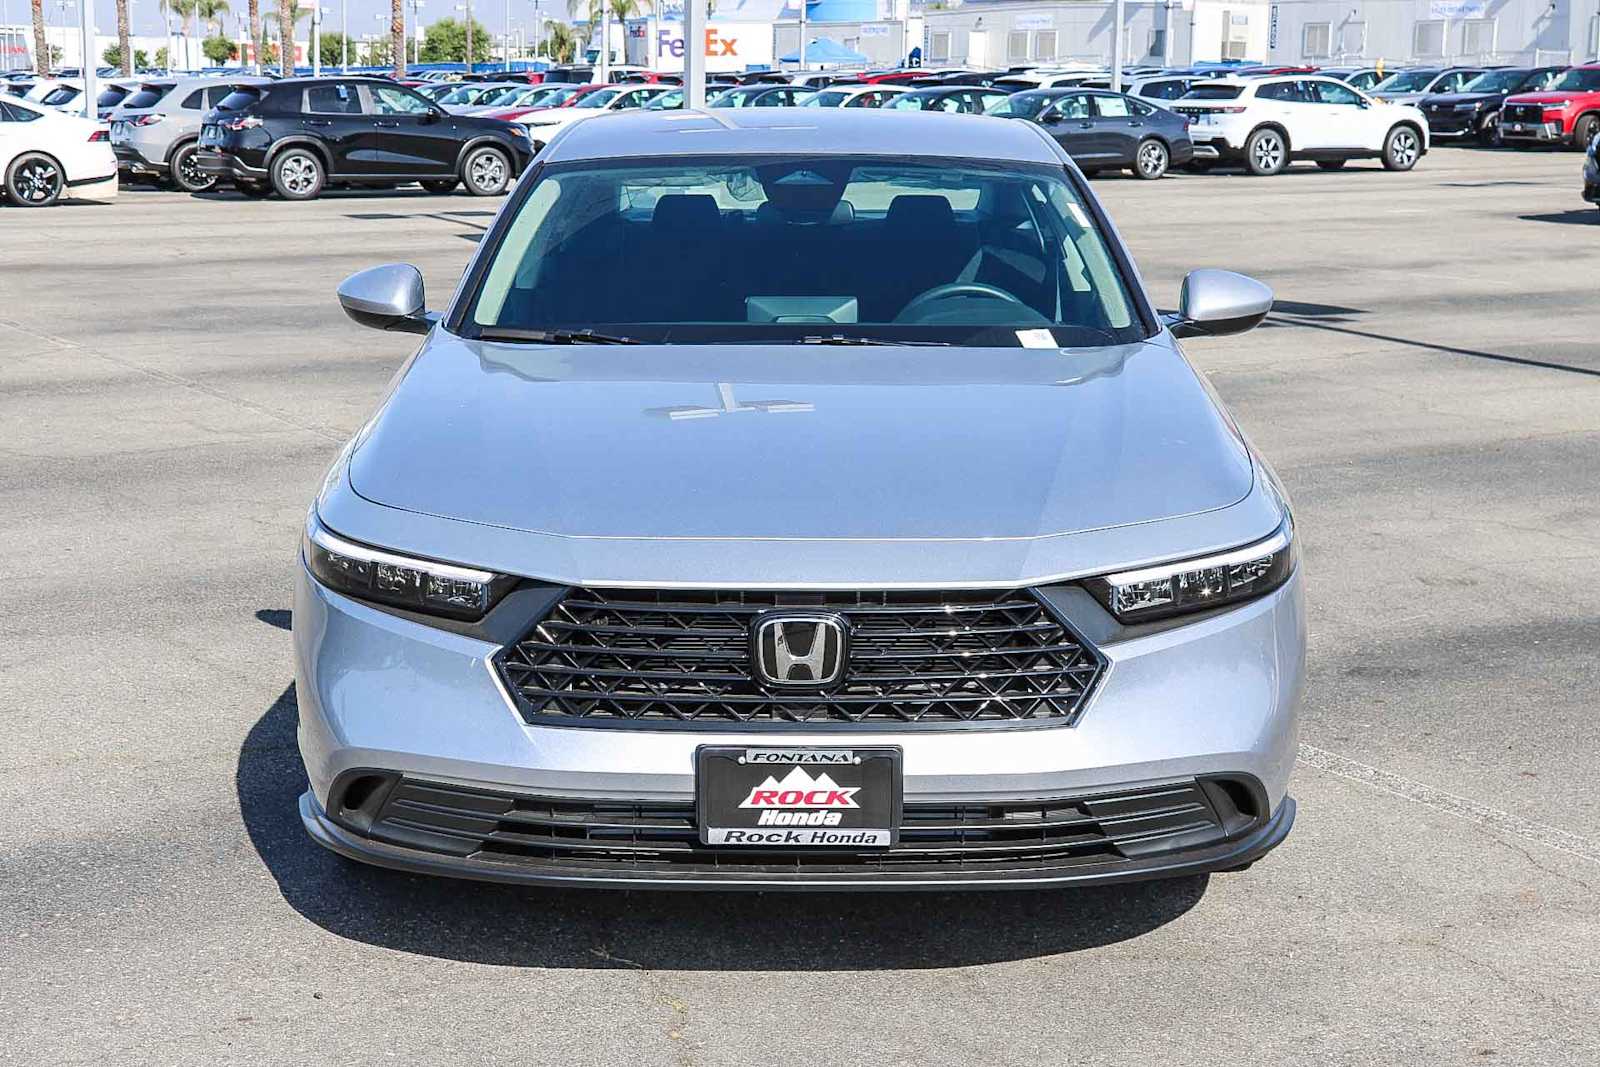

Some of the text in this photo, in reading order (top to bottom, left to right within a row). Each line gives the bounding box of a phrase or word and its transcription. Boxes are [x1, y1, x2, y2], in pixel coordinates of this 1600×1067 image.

[658, 28, 738, 57] FeEx
[753, 753, 849, 762] FONTANA
[751, 790, 850, 805] ROCK
[758, 809, 842, 826] Honda
[724, 831, 878, 844] Rock Honda
